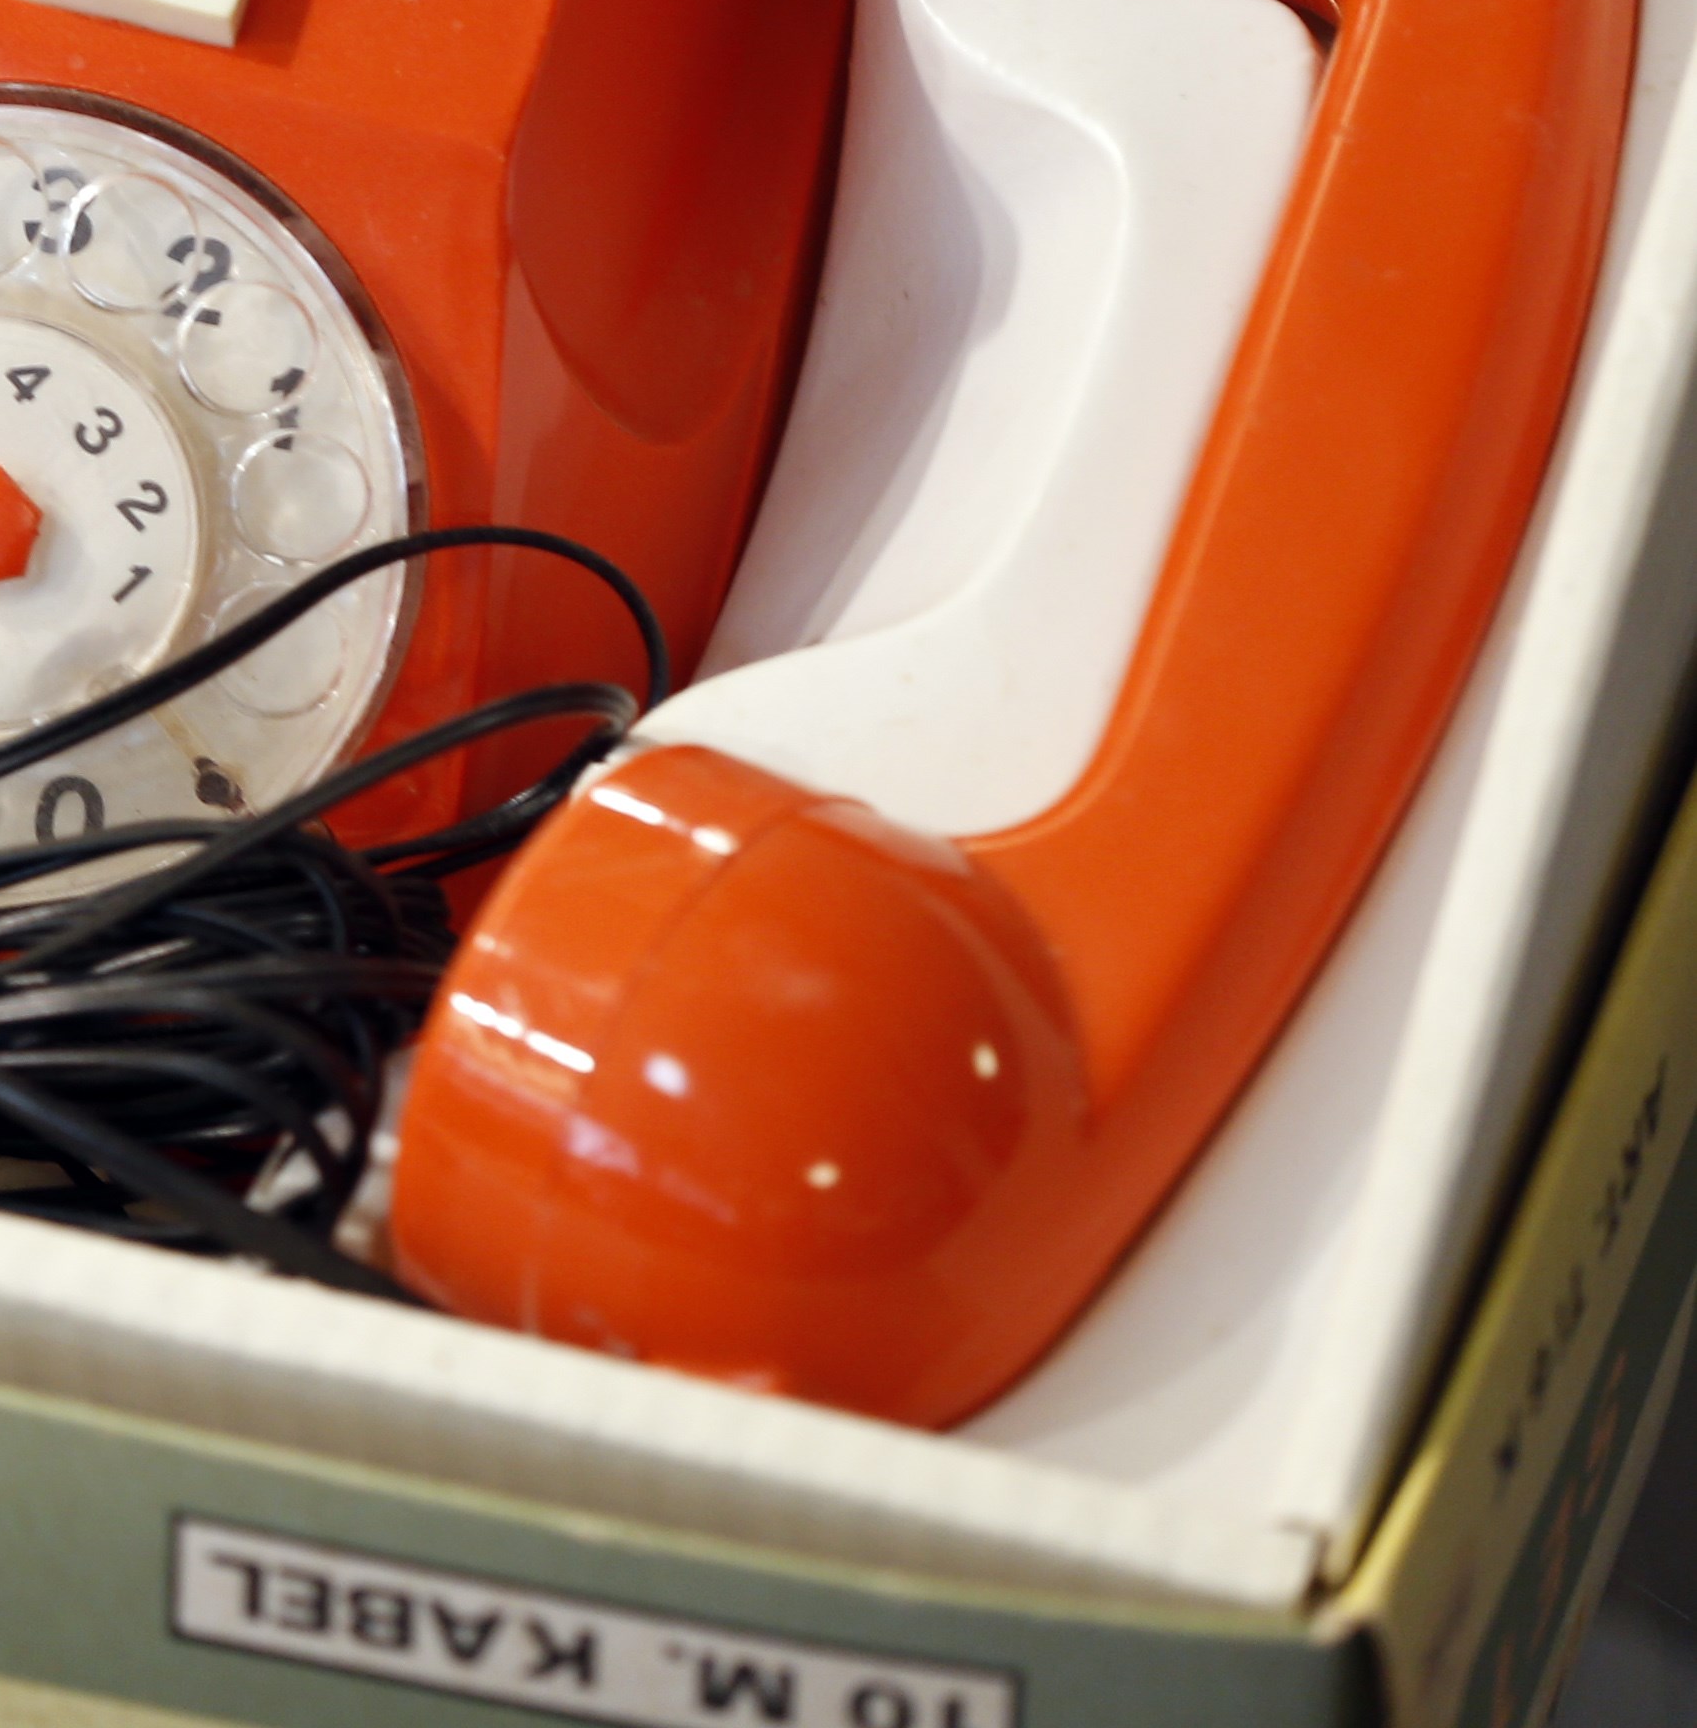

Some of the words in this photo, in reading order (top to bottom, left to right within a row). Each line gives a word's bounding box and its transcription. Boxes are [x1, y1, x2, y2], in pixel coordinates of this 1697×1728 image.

[22, 166, 93, 256] 3
[160, 235, 232, 328] 2
[4, 362, 53, 404] 4
[269, 366, 306, 453] 1
[74, 406, 125, 456] 3
[115, 479, 170, 534] 2
[109, 564, 155, 606] 1
[209, 1552, 600, 1687] KABEL
[661, 1638, 797, 1728] M.
